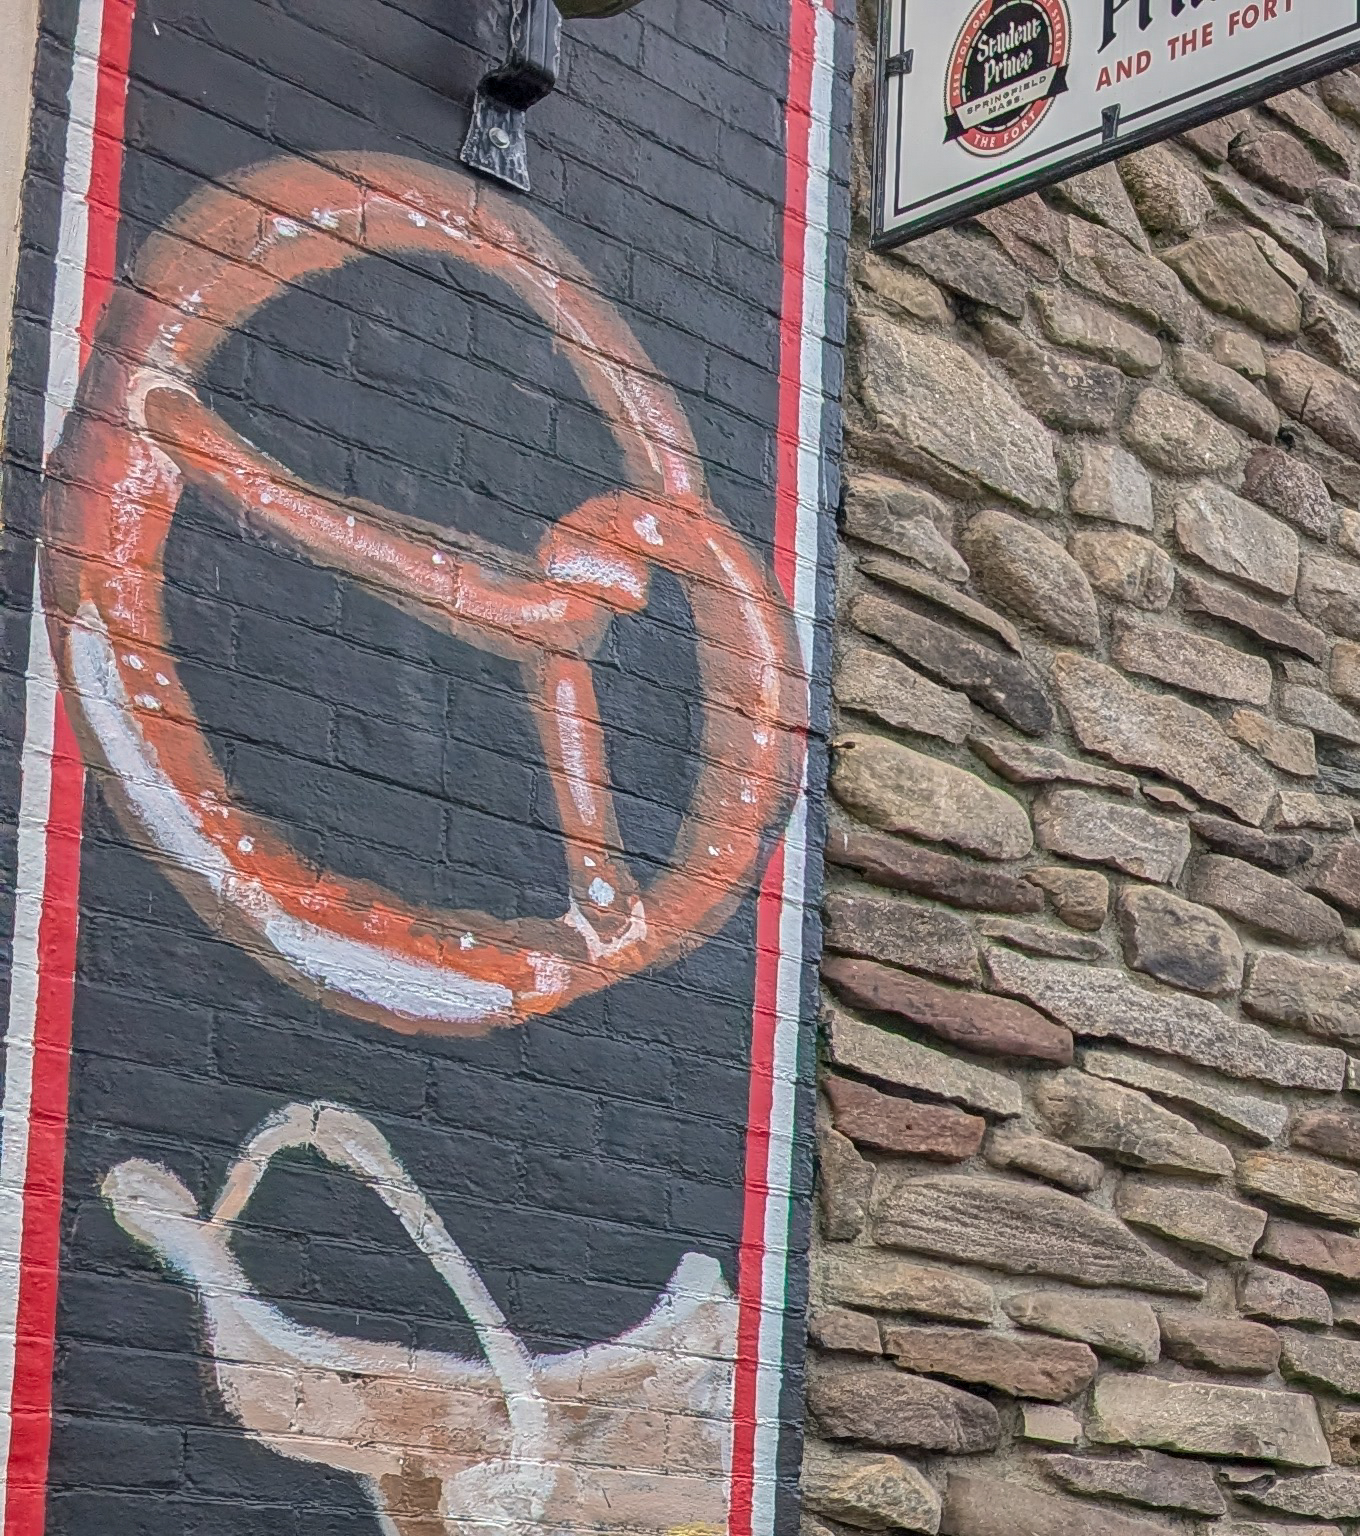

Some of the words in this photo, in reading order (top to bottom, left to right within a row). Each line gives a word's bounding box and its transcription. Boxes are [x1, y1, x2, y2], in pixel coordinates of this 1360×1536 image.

[953, 73, 961, 97] SEE
[957, 35, 972, 65] YOU
[972, 10, 987, 29] ON
[976, 18, 1042, 63] Student
[1051, 8, 1063, 55] STREET
[983, 48, 1033, 94] Prince
[1095, 50, 1152, 92] AND
[1167, 22, 1213, 61] THE
[966, 75, 1047, 115] SPRINGFIELD
[988, 97, 1024, 116] MASS.
[973, 133, 996, 148] THE
[1003, 110, 1037, 144] FORT
